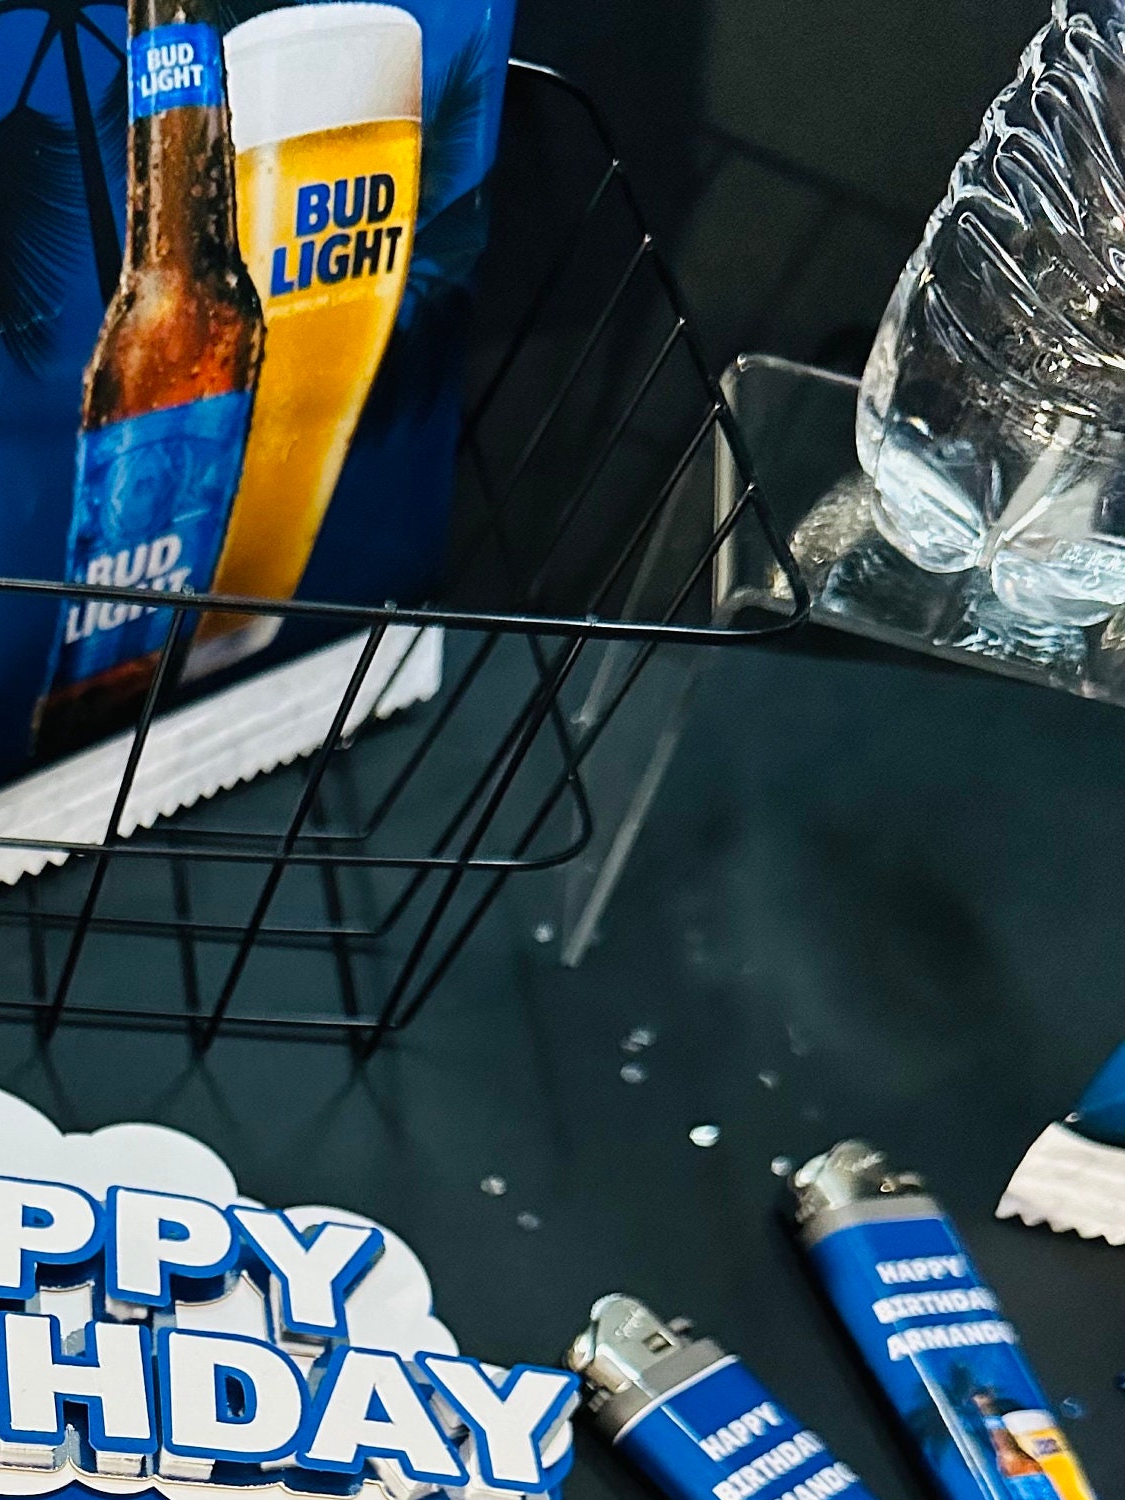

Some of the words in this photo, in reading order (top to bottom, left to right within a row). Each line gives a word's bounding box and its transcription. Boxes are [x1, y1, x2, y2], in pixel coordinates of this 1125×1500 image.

[140, 64, 204, 98] LIGHT
[147, 43, 194, 72] BUD
[295, 174, 395, 237] BUD
[270, 227, 403, 297] LIGHT
[875, 1253, 970, 1285] HAPPY
[699, 1401, 783, 1462] HAPPY
